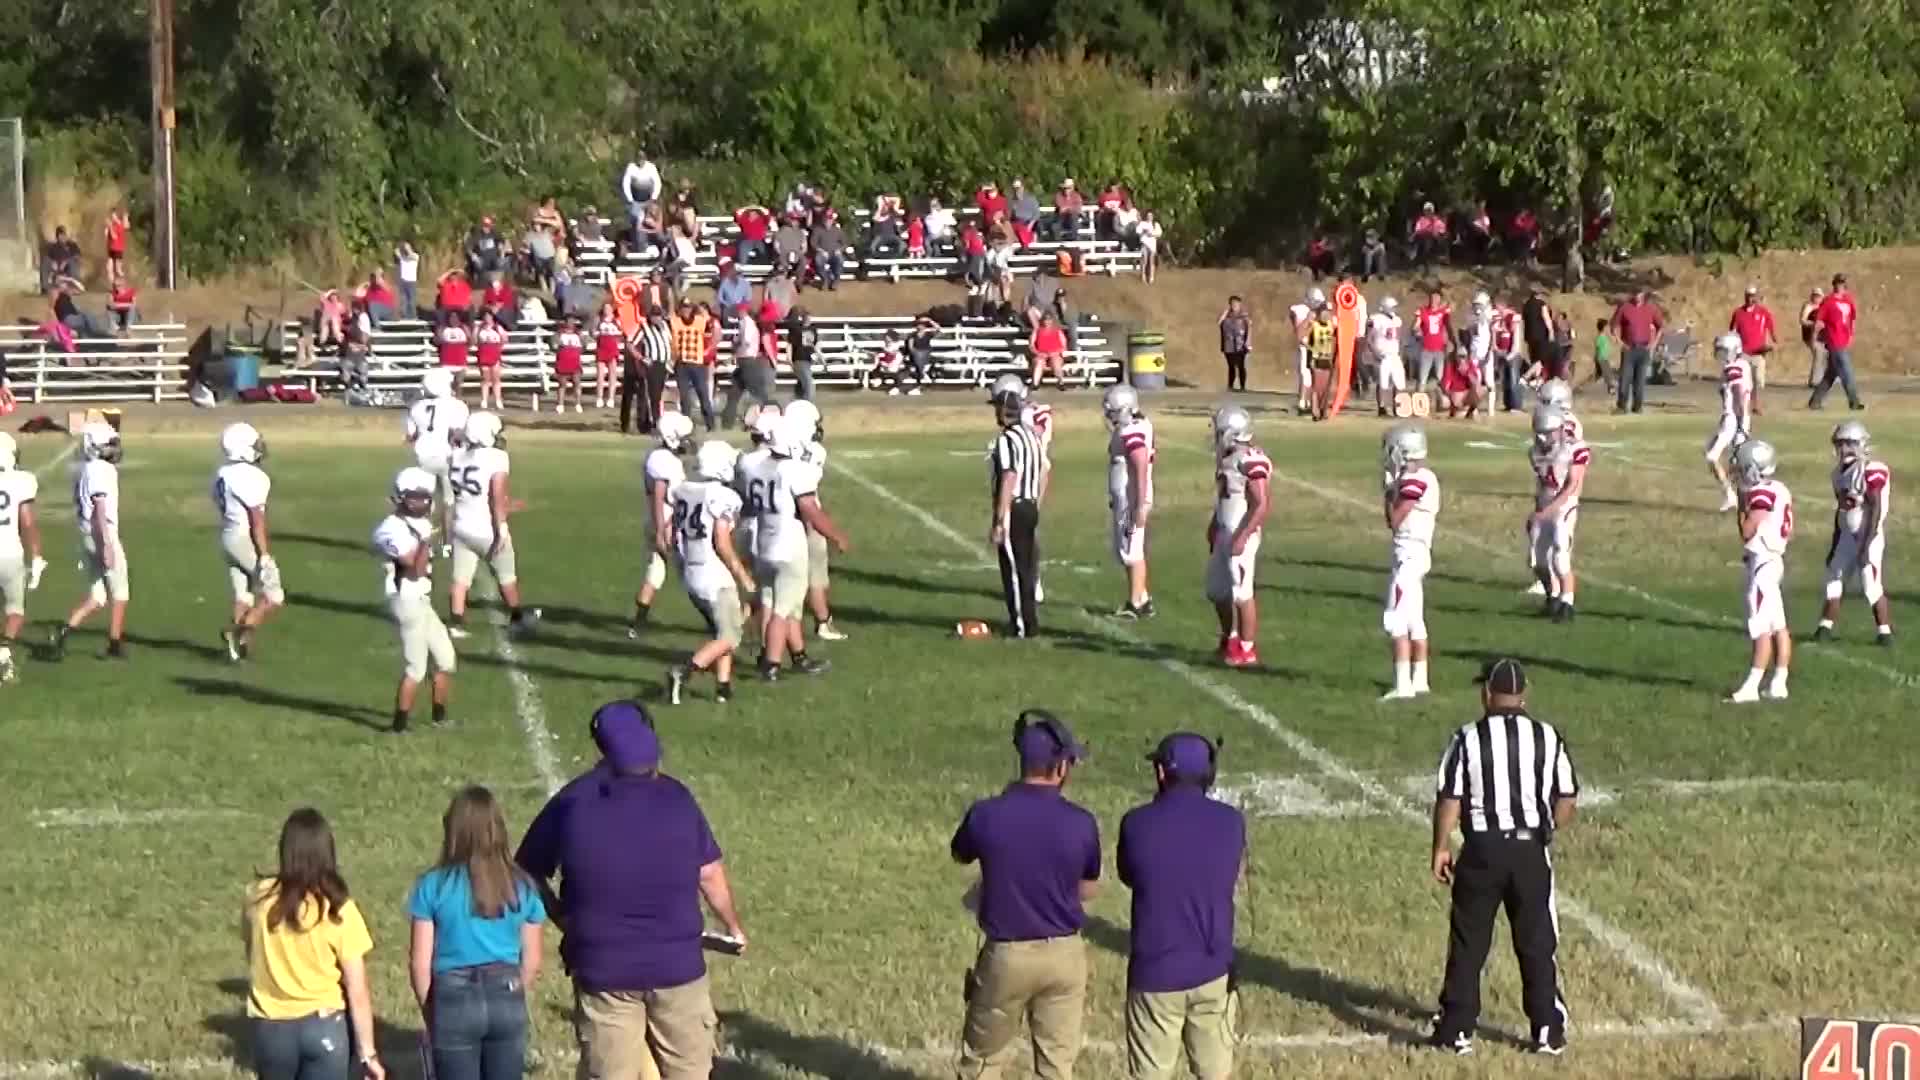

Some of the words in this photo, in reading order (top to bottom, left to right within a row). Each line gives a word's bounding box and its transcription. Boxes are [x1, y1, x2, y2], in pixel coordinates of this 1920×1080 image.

[426, 404, 436, 431] 7
[1395, 392, 1430, 417] 30
[750, 478, 779, 517] 61
[1802, 1020, 1920, 1080] 40
